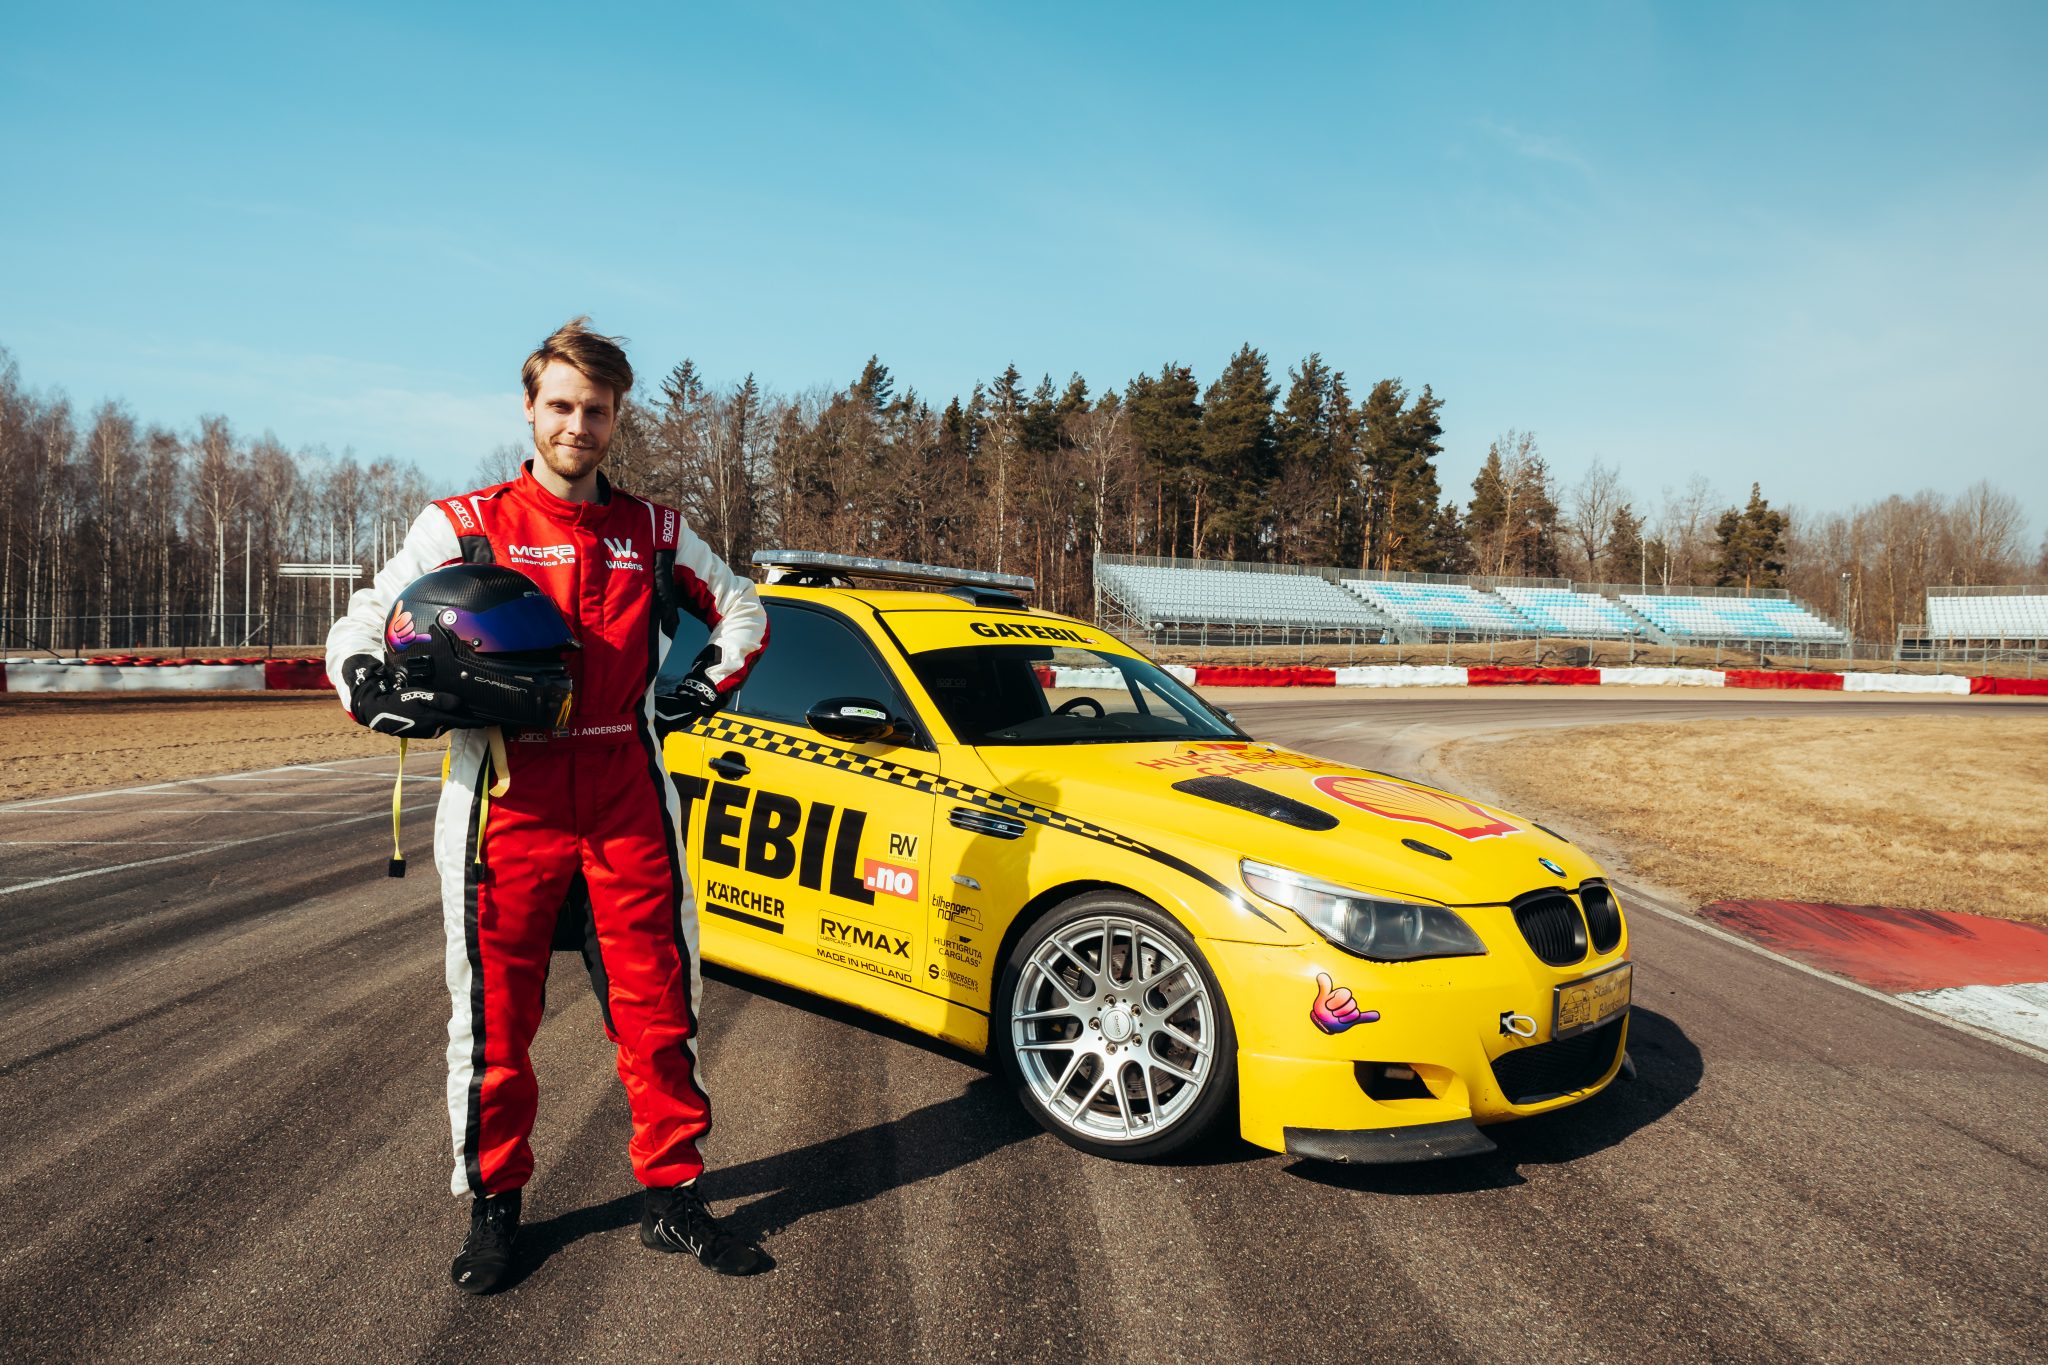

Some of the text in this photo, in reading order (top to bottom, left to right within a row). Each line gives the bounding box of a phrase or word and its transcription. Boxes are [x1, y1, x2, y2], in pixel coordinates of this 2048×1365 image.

[448, 500, 475, 529] sparco
[508, 544, 576, 559] MGRA
[511, 557, 576, 567] Bilservice AB
[605, 560, 644, 571] Wilzéns
[969, 622, 1094, 645] GATEBIL
[400, 691, 434, 702] sparco
[572, 723, 632, 737] J. ANDERSSON
[706, 879, 785, 919] KÄRCHER
[820, 935, 852, 948] LUBRICANTS
[821, 917, 911, 960] RYMAX
[934, 937, 983, 961] HURTIGRUTA
[817, 948, 912, 983] MADE IN HOLLAND
